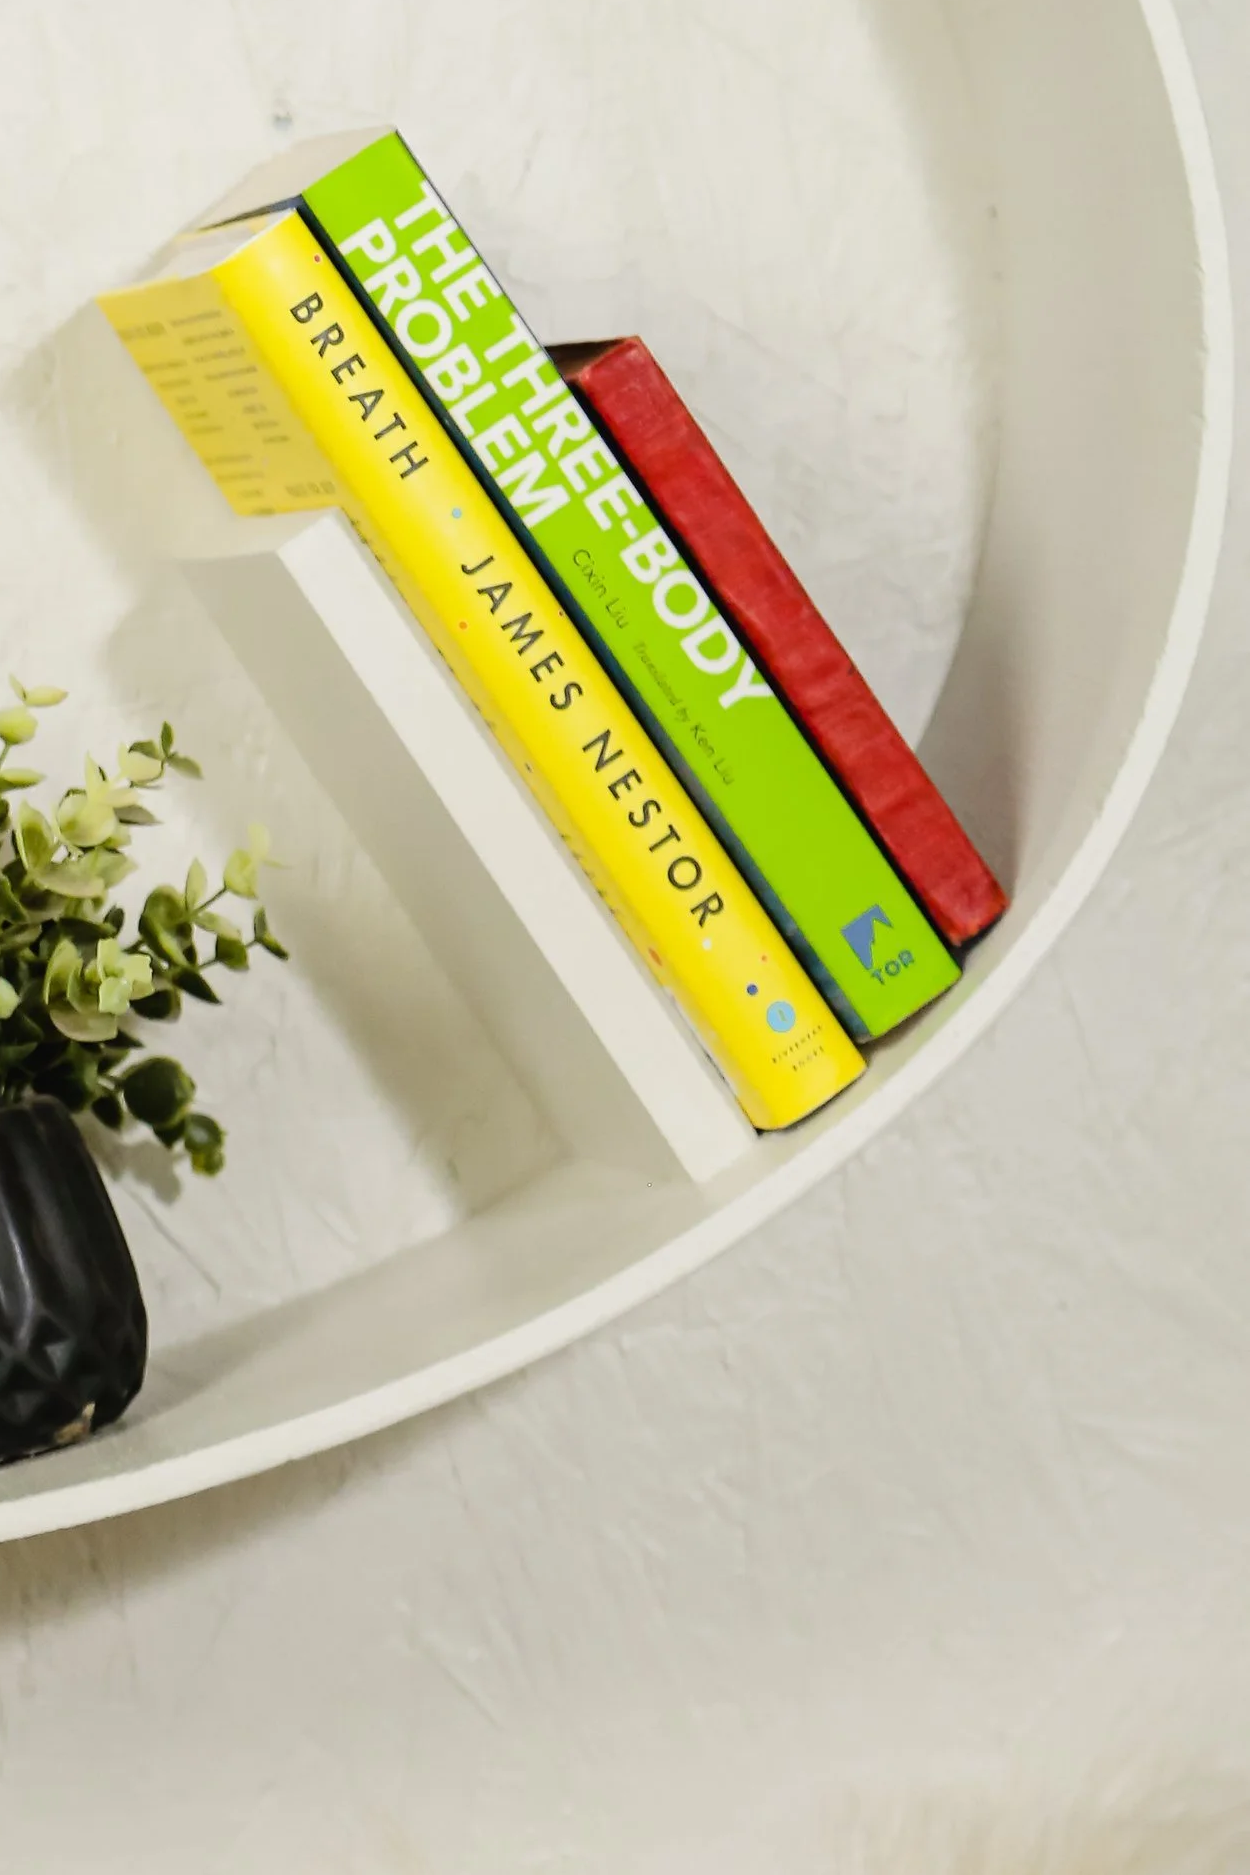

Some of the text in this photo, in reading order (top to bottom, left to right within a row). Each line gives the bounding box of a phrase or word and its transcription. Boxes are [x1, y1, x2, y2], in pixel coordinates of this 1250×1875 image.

[289, 290, 430, 481] BREATH
[337, 216, 572, 531] PROBLEM
[394, 178, 776, 711] THE THREE-BODY
[573, 548, 629, 630] Cixin Liu
[460, 554, 726, 929] JAMES NESTOR
[690, 722, 716, 759] Ken
[713, 756, 735, 787] Liu
[870, 949, 915, 986] TOR
